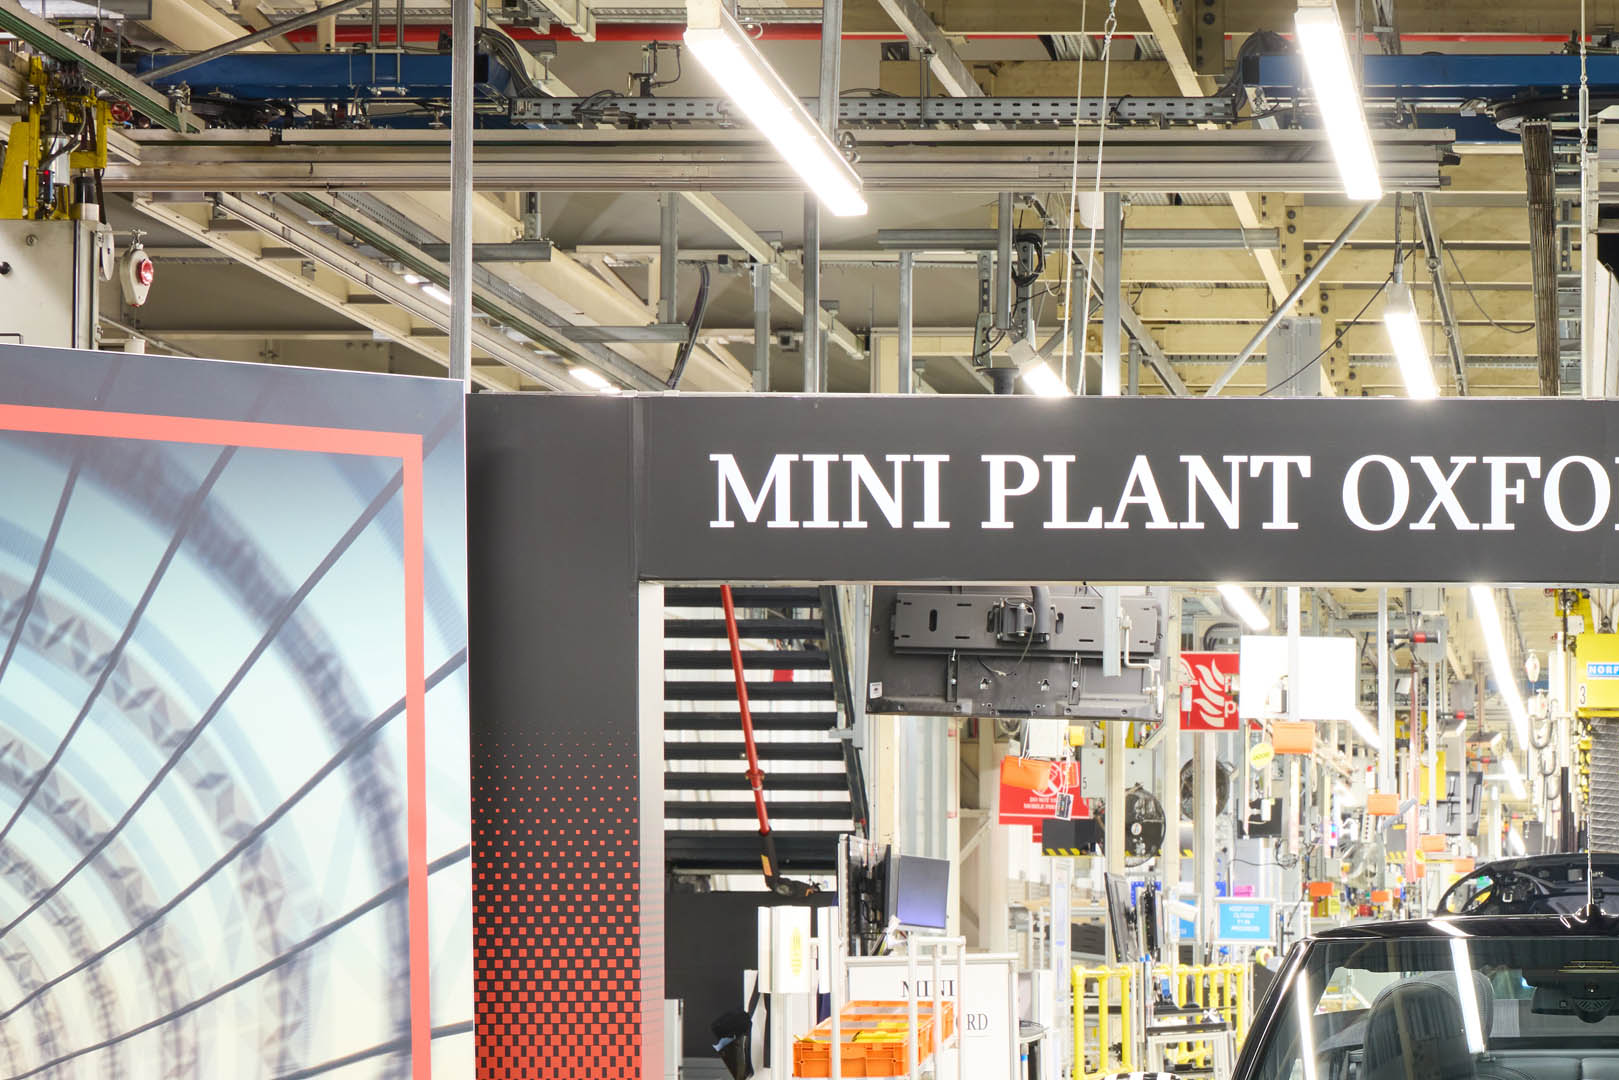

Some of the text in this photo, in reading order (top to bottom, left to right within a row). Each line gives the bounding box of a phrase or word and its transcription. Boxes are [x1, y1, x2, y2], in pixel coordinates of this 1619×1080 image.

[709, 454, 951, 529] MINI
[981, 454, 1312, 530] PLANT
[1579, 685, 1587, 705] 3
